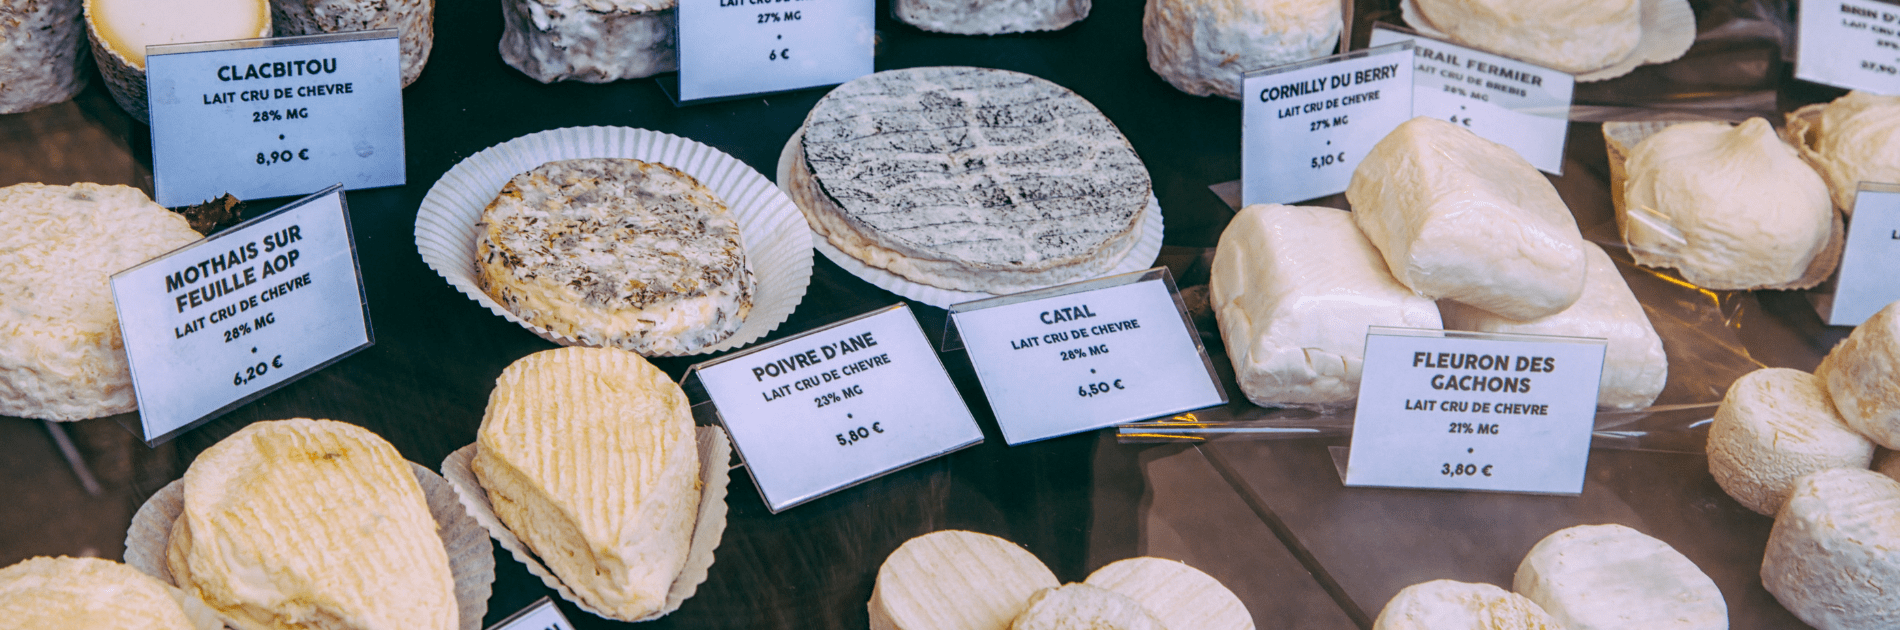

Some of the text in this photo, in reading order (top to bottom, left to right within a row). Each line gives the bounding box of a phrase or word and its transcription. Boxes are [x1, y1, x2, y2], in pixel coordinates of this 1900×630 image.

[758, 10, 802, 24] 27% MG
[769, 48, 790, 61] 6 €
[217, 58, 337, 82] CLACBITOU
[1467, 60, 1542, 87] FERMIER
[203, 82, 354, 105] LAIT CRU DE CHEVRE
[1260, 64, 1398, 103] CORNILLY DU BERRY
[1440, 71, 1463, 80] CRU
[1467, 77, 1481, 85] DE
[1486, 82, 1526, 97] BREBIS
[1278, 90, 1380, 119] LAIT CRU DE CHEVRE
[1470, 92, 1488, 102] MG
[253, 108, 308, 123] 28% MG
[1310, 115, 1348, 132] 27% MG
[1462, 118, 1471, 126] €
[256, 148, 310, 166] 8,90 €
[1311, 152, 1345, 169] 5,10 €
[166, 225, 303, 293] MOTHAIS SUR
[176, 249, 300, 314] FEUILLE AOP
[175, 272, 312, 339] LAIT CRU DE CHEVRE
[1040, 305, 1097, 325] CATAL
[224, 312, 276, 343] 28% MG
[1011, 319, 1141, 350] LAIT CRU DE CHEVRE
[752, 332, 878, 382] POIVRE D'ANE
[1060, 344, 1109, 361] 28% MG
[1413, 352, 1555, 373] FLEURON DES
[234, 354, 284, 386] 6,20 €
[762, 353, 891, 402] LAIT CRU DE CHEVRE
[1078, 379, 1125, 398] 6,50 €
[1431, 374, 1531, 393] GACHONS
[814, 385, 864, 408] 23% MG
[1405, 399, 1548, 416] LAIT CRU DE CHEVRE
[836, 422, 884, 446] 5,80 €
[1448, 422, 1499, 435] 21% MG
[1441, 463, 1493, 477] 3,80 €
